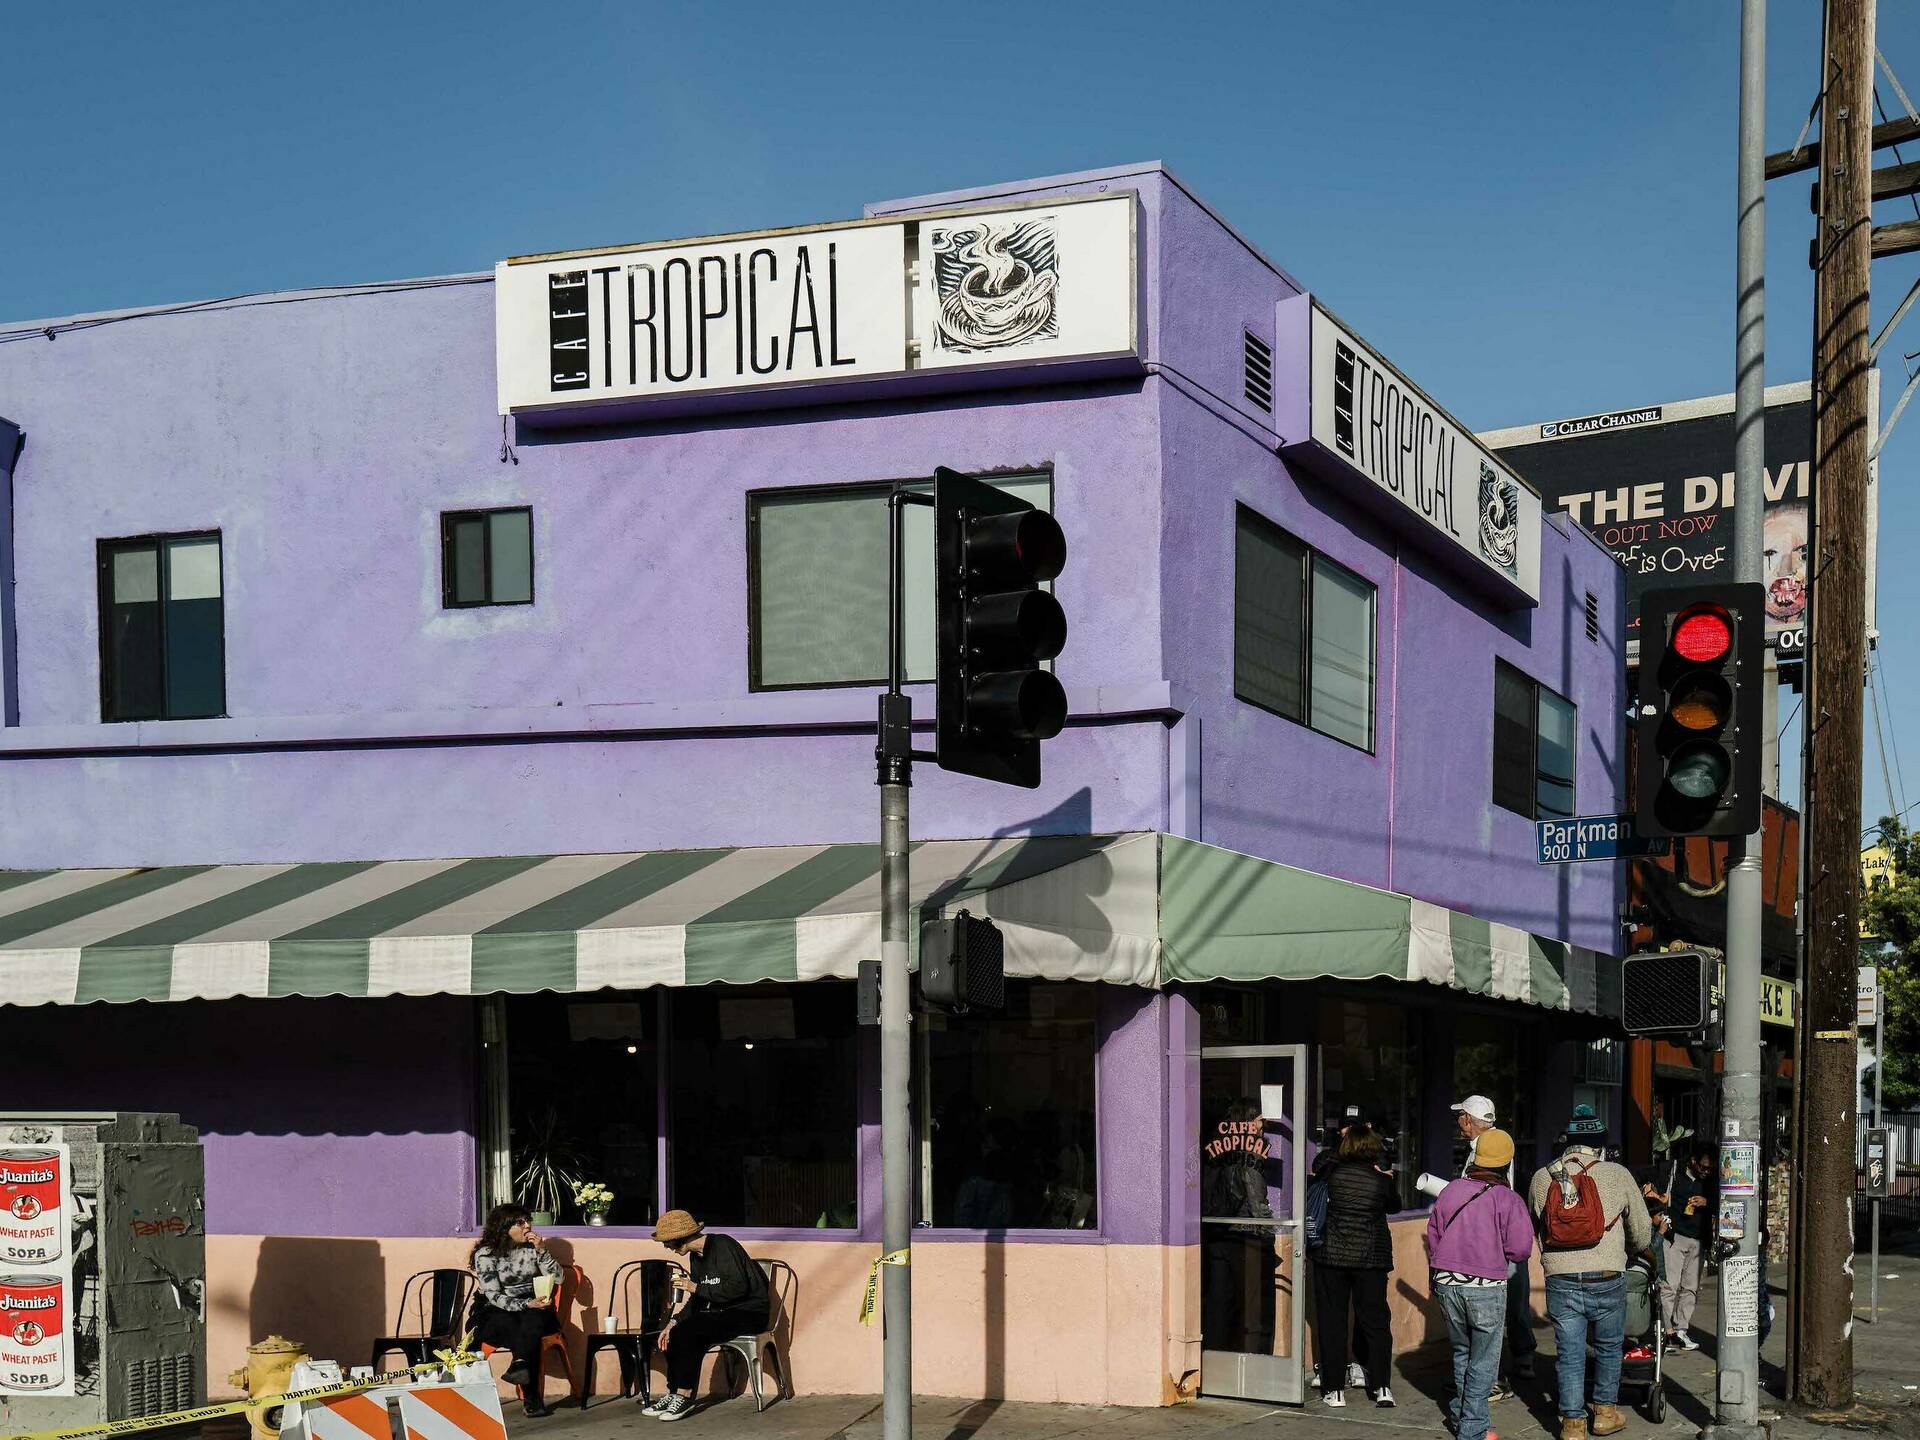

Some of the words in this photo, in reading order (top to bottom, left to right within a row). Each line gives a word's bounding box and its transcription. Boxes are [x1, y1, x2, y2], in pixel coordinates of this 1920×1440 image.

[592, 243, 856, 388] TROPICAL
[552, 277, 587, 383] CAFE
[1336, 346, 1354, 451] CAFE
[1356, 355, 1460, 538] TROPICAL
[1559, 482, 1664, 525] THE
[1604, 525, 1650, 546] OUT
[1658, 515, 1718, 539] NOW
[1638, 552, 1657, 574] is
[1661, 546, 1726, 573] Over
[1543, 820, 1631, 846] Parkman
[1543, 844, 1571, 861] 900
[1577, 842, 1587, 859] N
[1763, 981, 1783, 1018] KE
[1857, 985, 1873, 993] tro
[1218, 1121, 1258, 1135] CAFE
[1205, 1135, 1272, 1160] TROPICAL
[0, 1167, 54, 1184] Juanita's
[0, 1226, 28, 1239] WHEAT
[30, 1226, 55, 1239] PASTE
[8, 1247, 46, 1258] SOPA
[0, 1293, 56, 1310] Juanita's
[2, 1351, 30, 1365] WHEAT
[33, 1352, 57, 1365] PASTE
[10, 1373, 49, 1384] SOPA
[281, 1386, 321, 1401] TRAFFIC
[323, 1382, 344, 1394] LINE
[352, 1377, 366, 1387] DO
[367, 1373, 387, 1384] NOT
[387, 1367, 416, 1380] CROSS
[57, 1429, 108, 1440] TRAFFIC
[109, 1424, 137, 1434] LINE
[166, 1414, 188, 1423] NOT
[190, 1407, 226, 1417] CROSS
